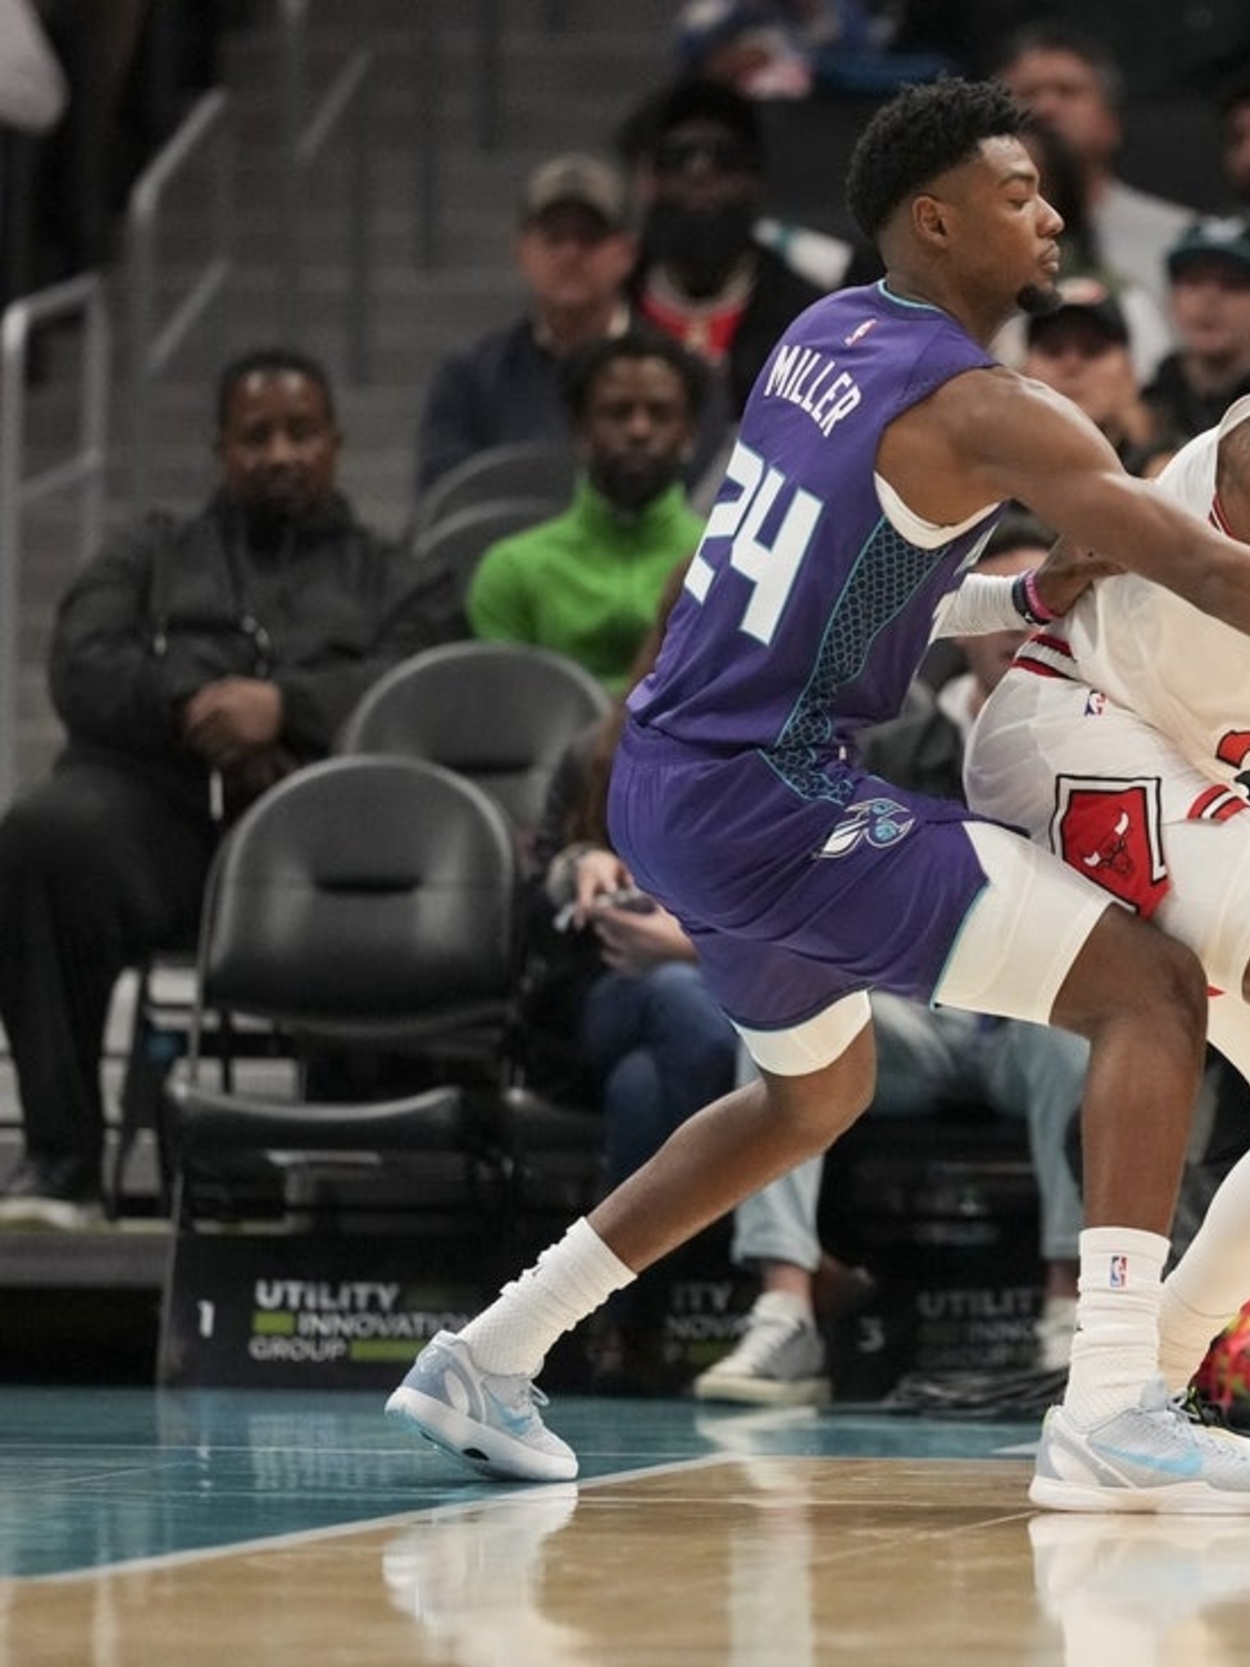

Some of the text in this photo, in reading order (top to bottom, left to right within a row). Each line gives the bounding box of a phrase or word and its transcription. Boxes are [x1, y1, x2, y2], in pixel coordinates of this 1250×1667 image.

[764, 344, 862, 437] MILLER
[684, 439, 824, 646] 24
[255, 1280, 400, 1310] UTILITY
[917, 1288, 1035, 1319] UTILIT
[198, 1300, 214, 1338] 1
[297, 1312, 472, 1337] INNOVATIO
[858, 1316, 885, 1353] 3
[248, 1337, 347, 1362] GROUP
